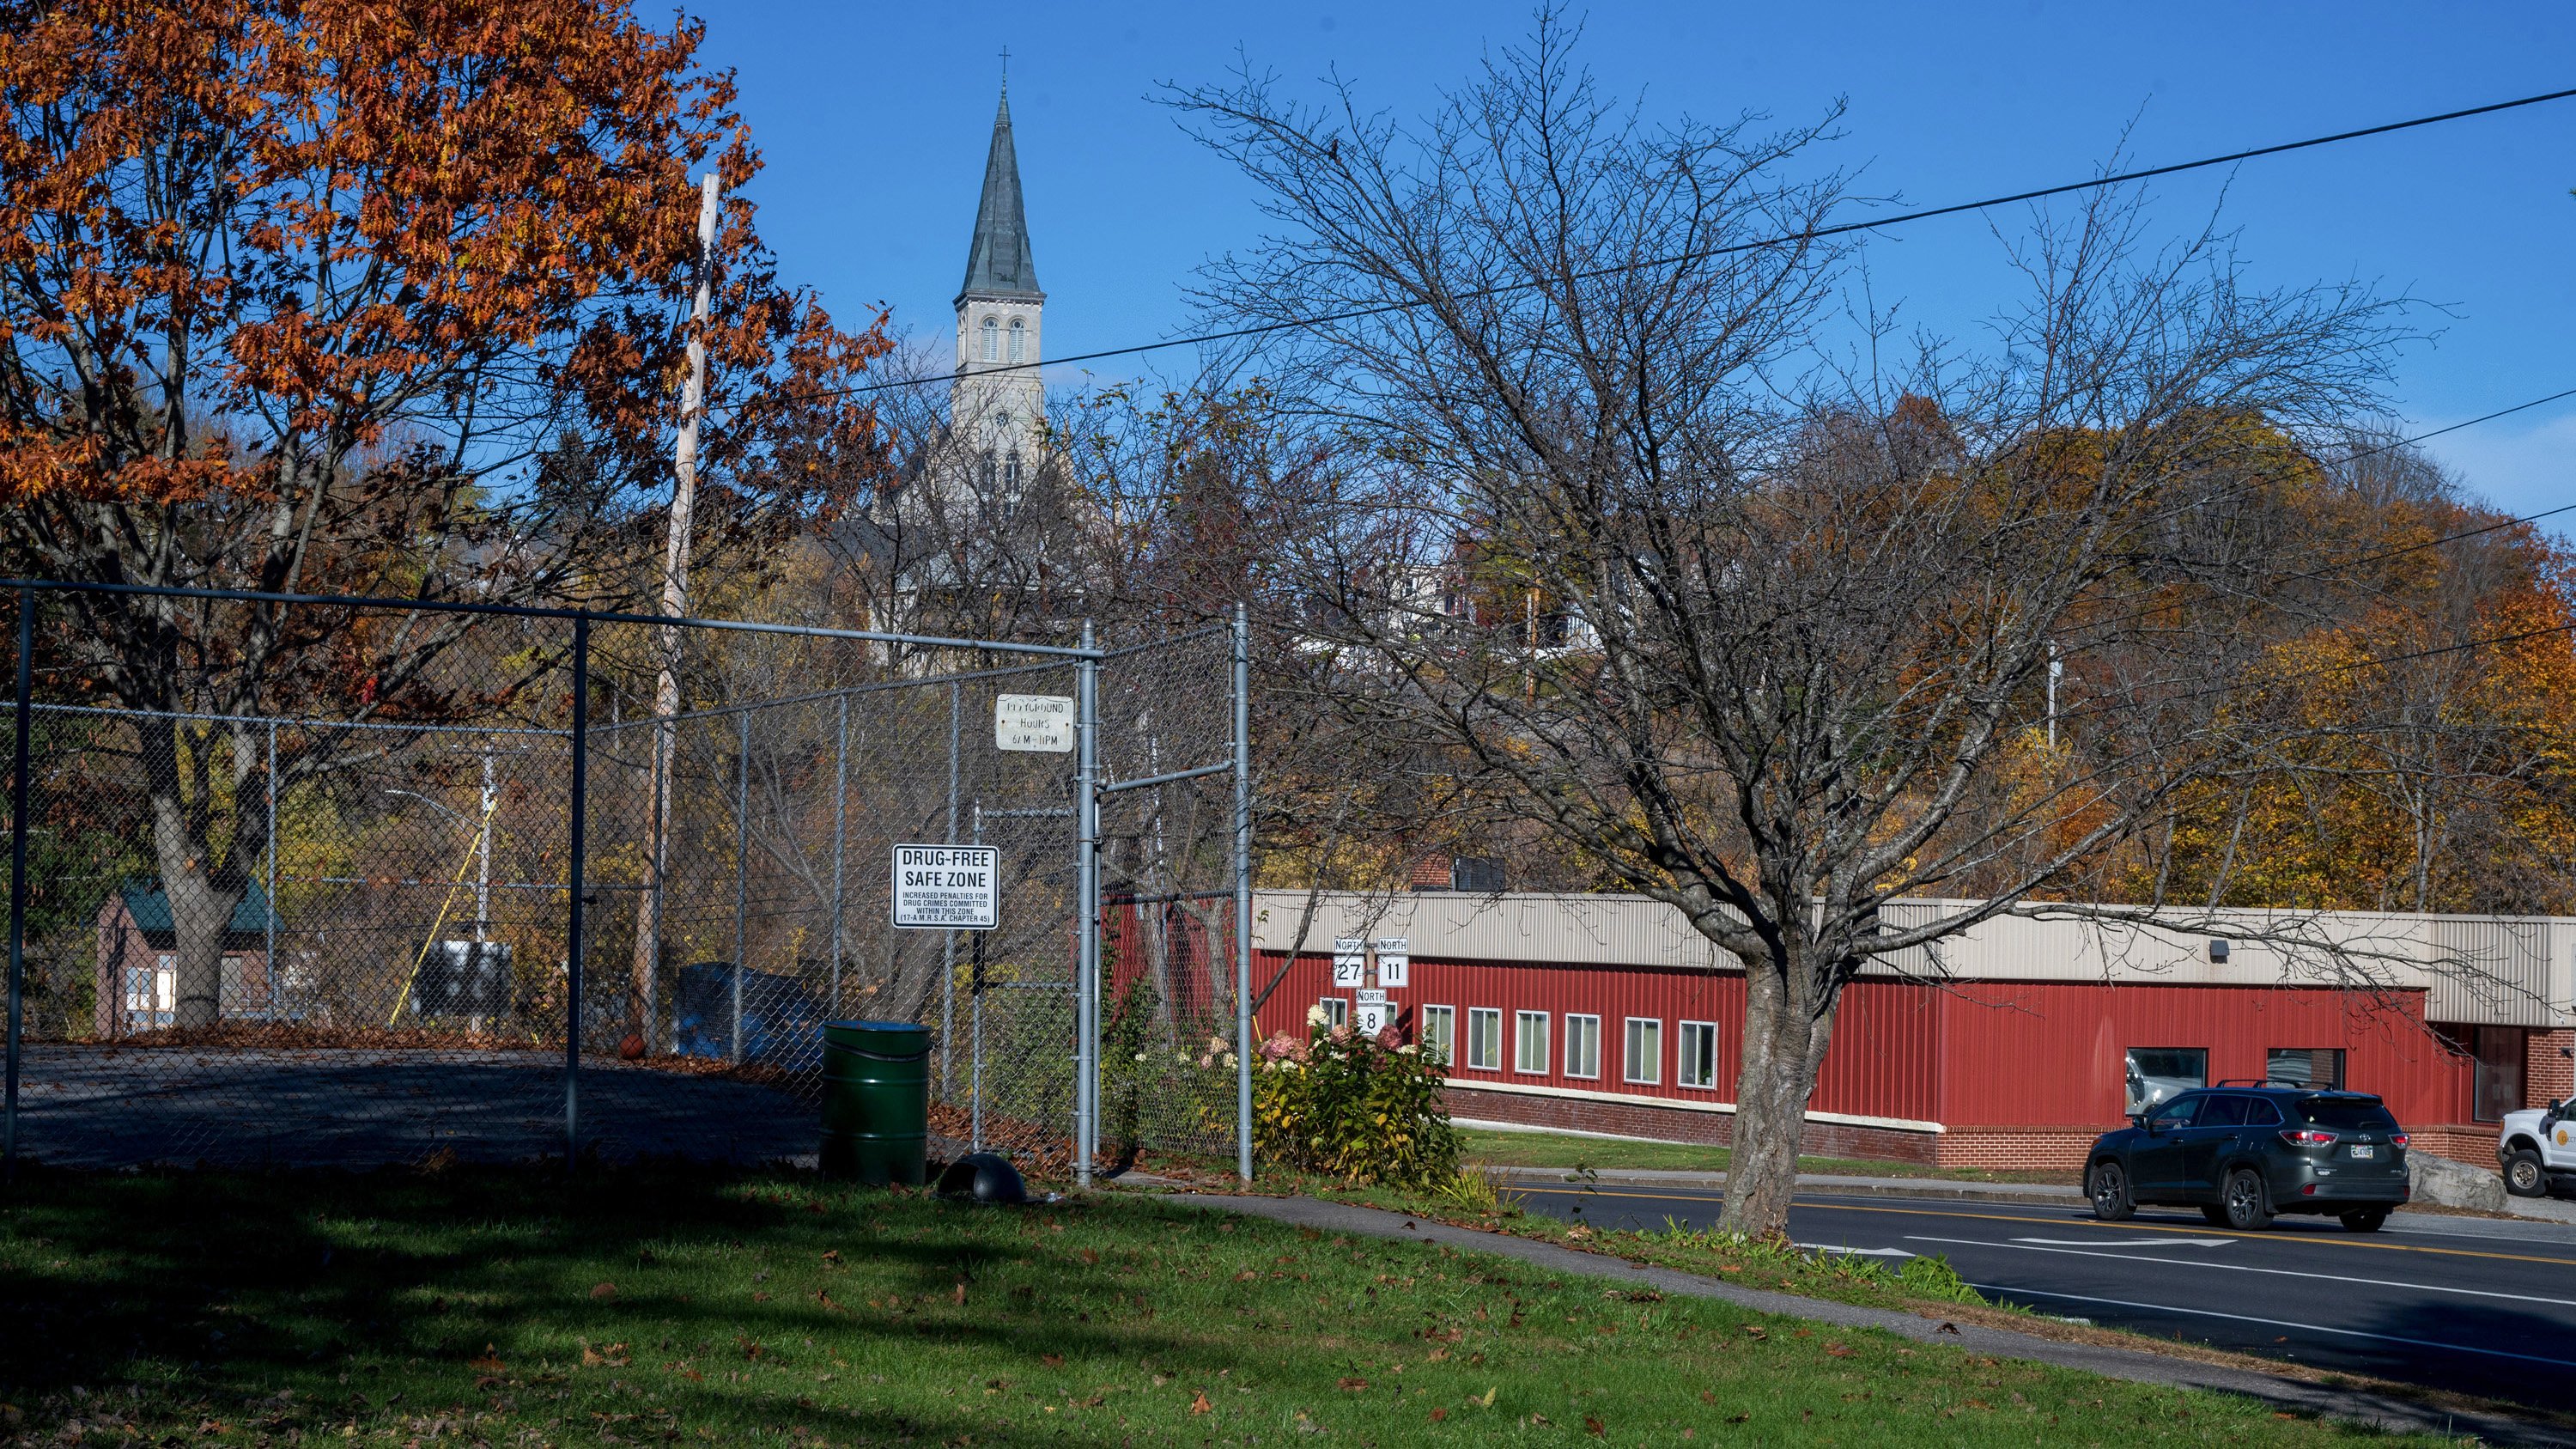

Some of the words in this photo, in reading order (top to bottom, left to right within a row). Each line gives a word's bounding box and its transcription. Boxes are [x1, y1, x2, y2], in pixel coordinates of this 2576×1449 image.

[1020, 718, 1050, 729] HOURS
[902, 850, 988, 867] DRUG-FREE
[905, 871, 942, 886] SAFE
[947, 872, 986, 887] ZONE
[1335, 940, 1363, 950] NORTH
[1380, 940, 1406, 950] NORTH
[1338, 964, 1361, 980] 27
[1387, 963, 1400, 980] 11
[1358, 991, 1385, 1002] NORTH
[1367, 1013, 1376, 1029] 8
